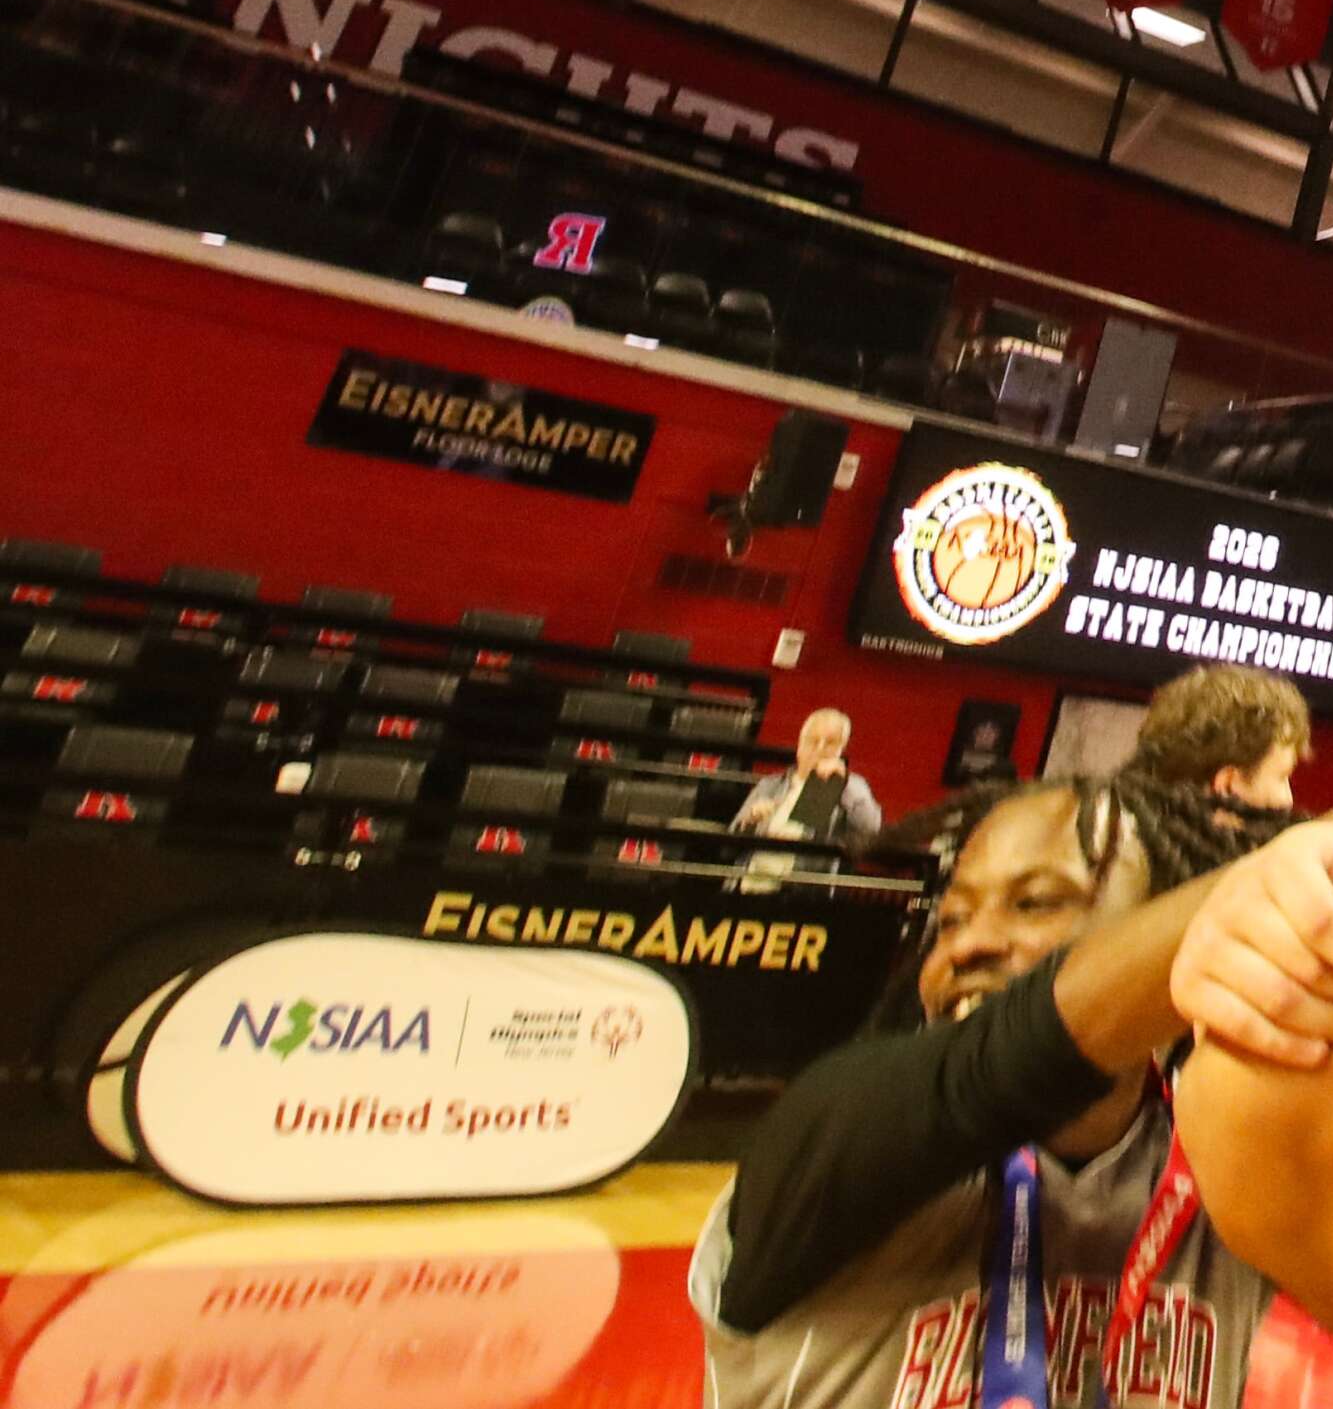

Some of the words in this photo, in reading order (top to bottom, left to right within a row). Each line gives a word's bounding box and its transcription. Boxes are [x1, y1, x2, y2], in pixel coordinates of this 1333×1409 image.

[1208, 523, 1281, 573] 2026
[1092, 547, 1196, 605] NJSIAA
[1064, 595, 1163, 649] STATE
[422, 890, 828, 973] EISNERAMPER
[273, 1095, 432, 1136] Unified
[441, 1098, 573, 1140] Sports
